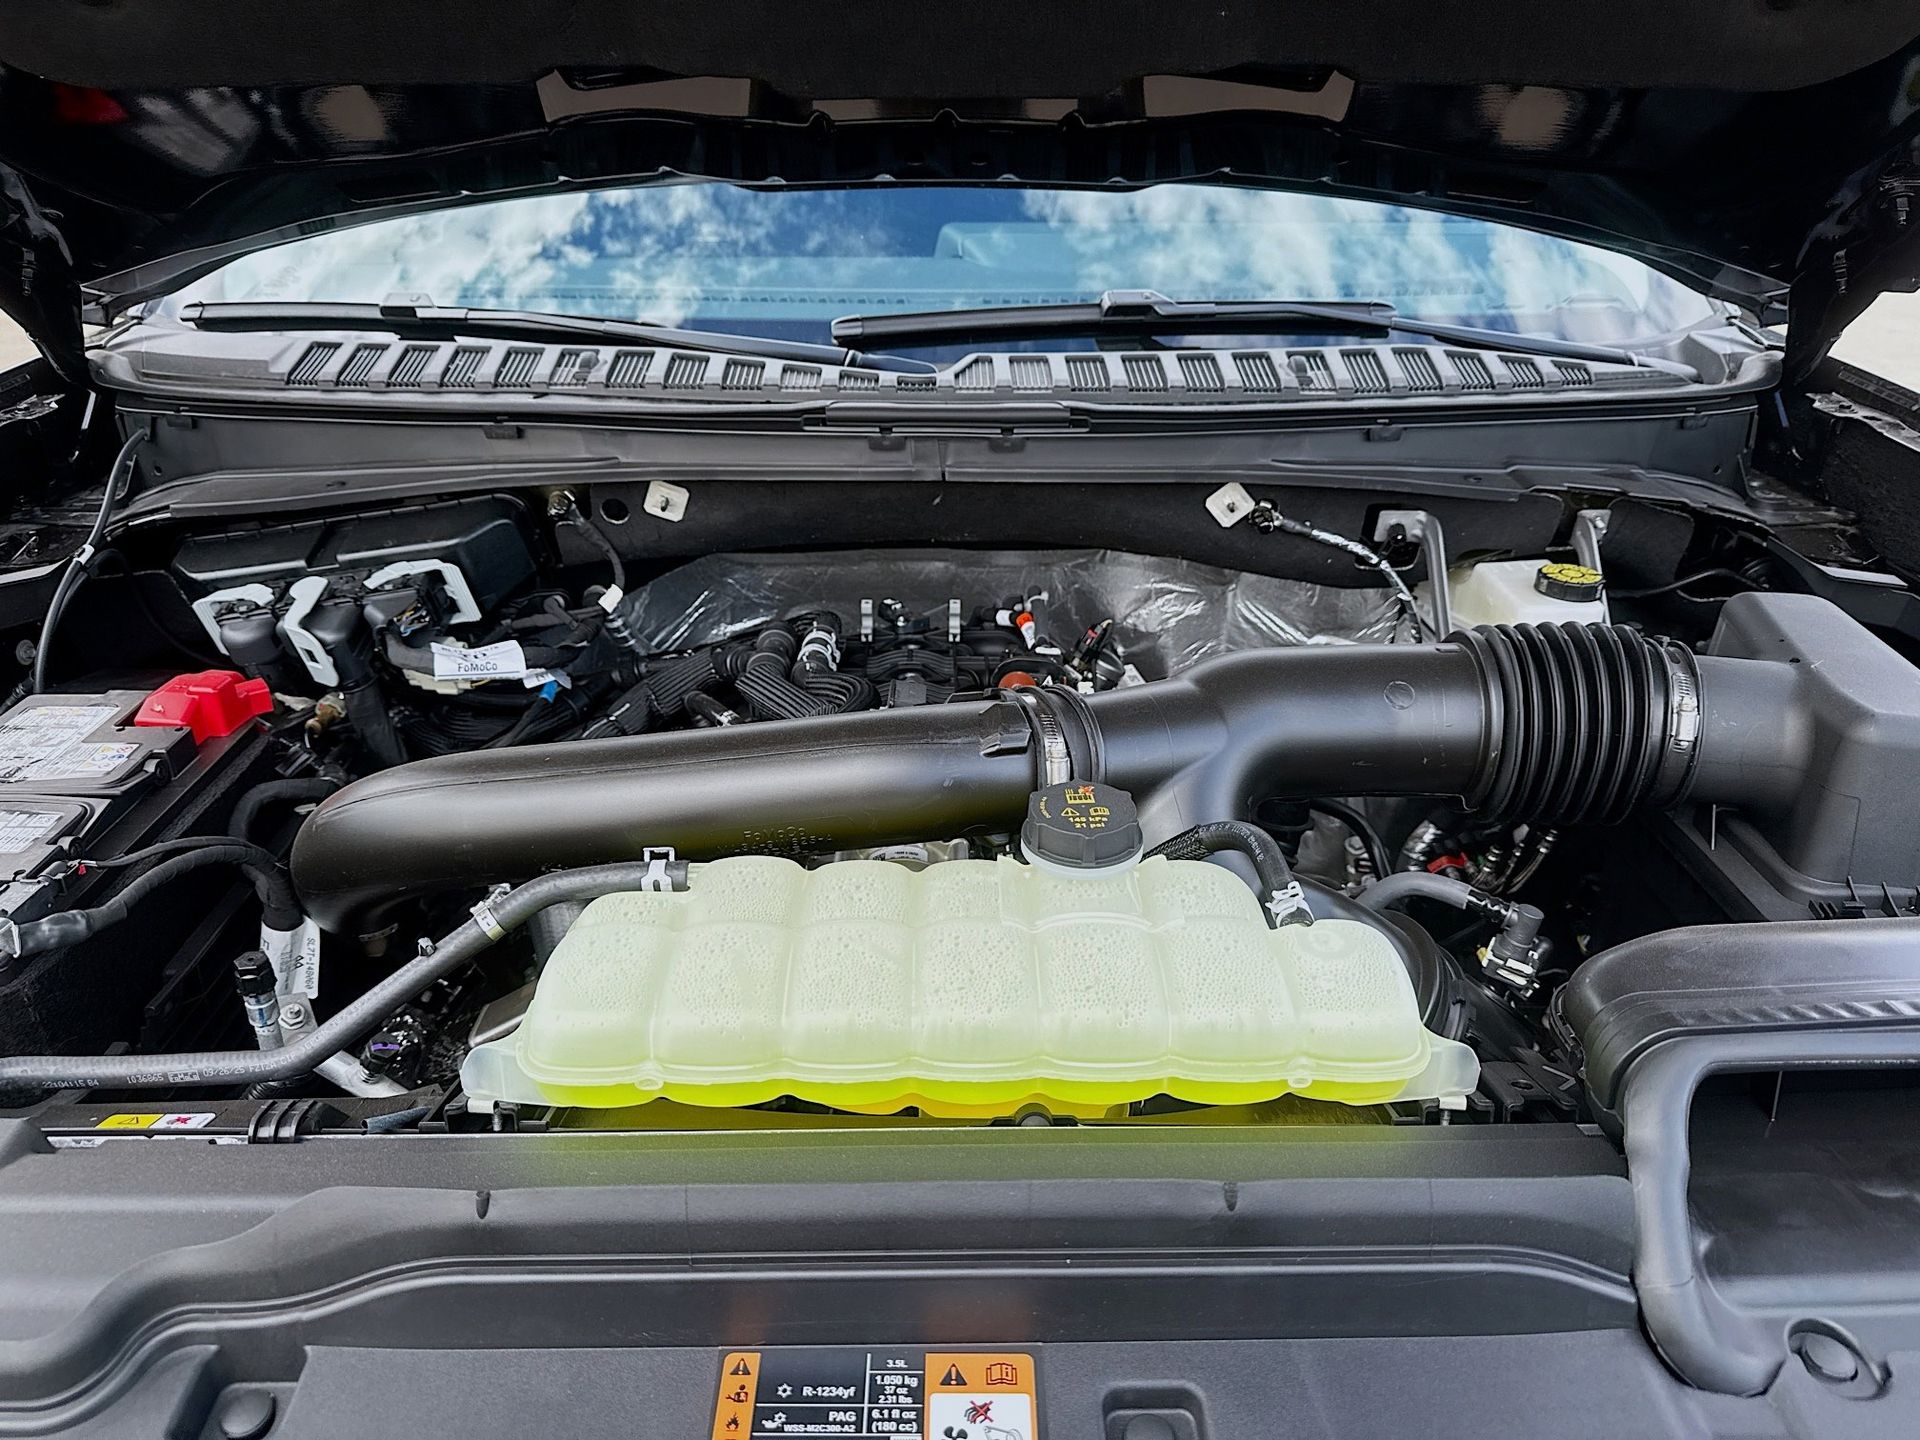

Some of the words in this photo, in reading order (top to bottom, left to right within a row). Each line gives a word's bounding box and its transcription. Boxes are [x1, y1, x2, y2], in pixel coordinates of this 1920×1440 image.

[457, 661, 498, 673] FoMoCo
[886, 1359, 908, 1368] 3.5L
[875, 1374, 903, 1385] 1.050
[904, 1374, 919, 1387] kg
[802, 1386, 856, 1400] R-1234yf
[884, 1386, 896, 1394] 37
[898, 1395, 913, 1404] lbs
[828, 1411, 857, 1422] PAG
[871, 1409, 889, 1419] 6.1
[890, 1409, 900, 1419] fl
[901, 1411, 917, 1419] oz
[871, 1421, 897, 1433] (180
[898, 1421, 918, 1433] cc)
